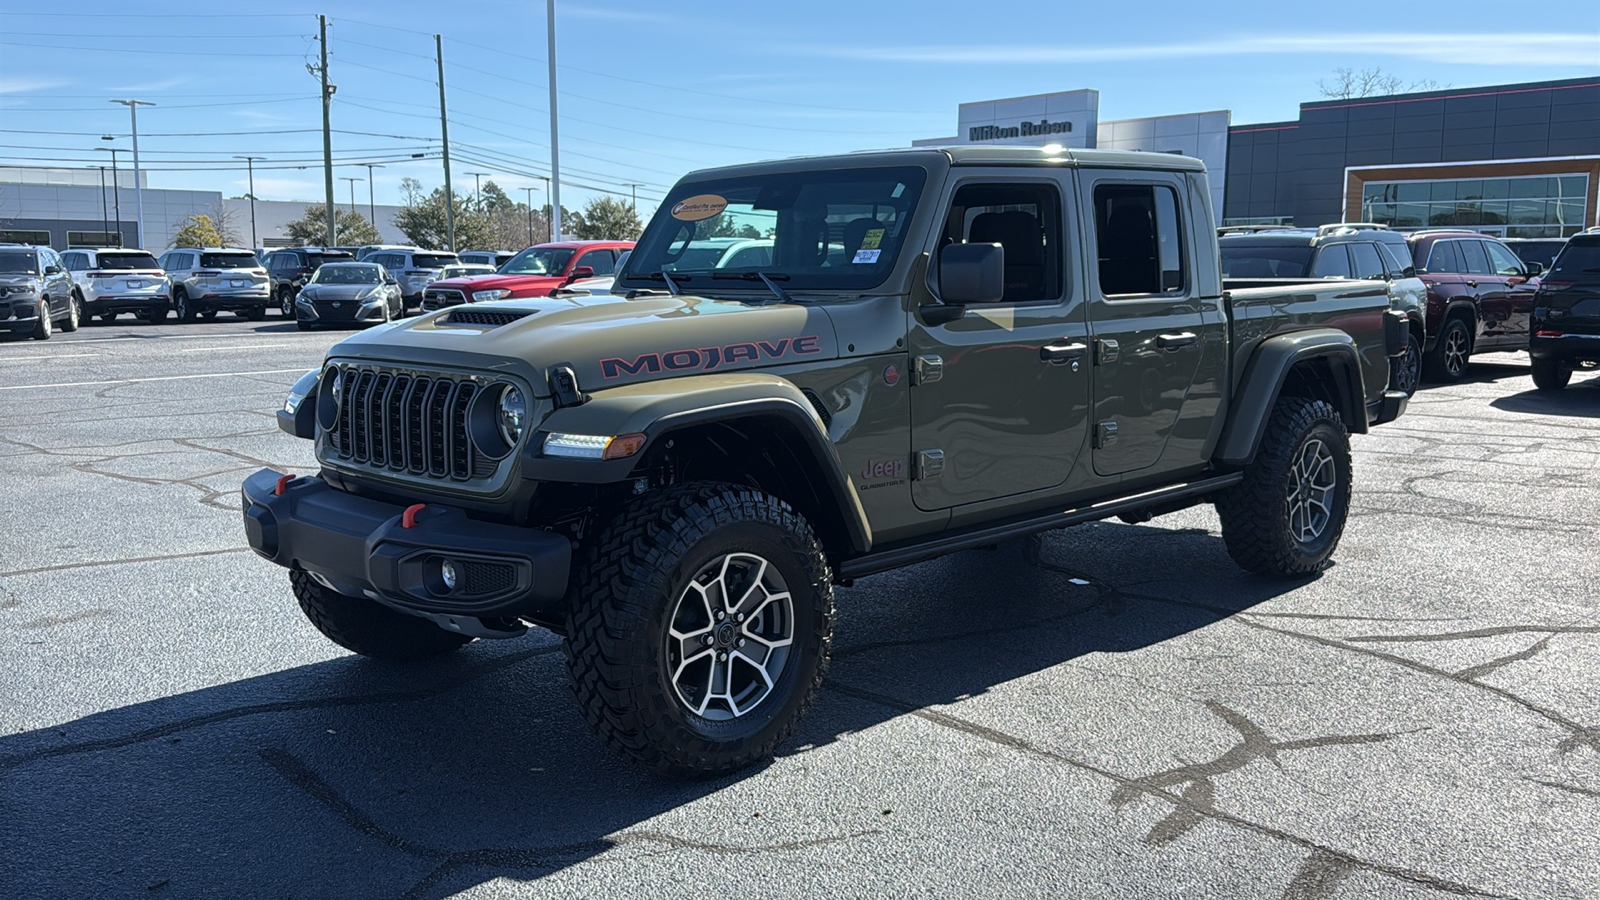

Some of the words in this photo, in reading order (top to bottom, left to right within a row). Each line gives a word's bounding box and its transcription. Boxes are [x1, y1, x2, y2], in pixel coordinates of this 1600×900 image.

[969, 125, 1019, 142] Milton
[1020, 120, 1073, 137] Ruben
[599, 336, 821, 379] MOJAVE
[861, 460, 904, 479] Jeep
[860, 480, 899, 490] GLADIATOR
